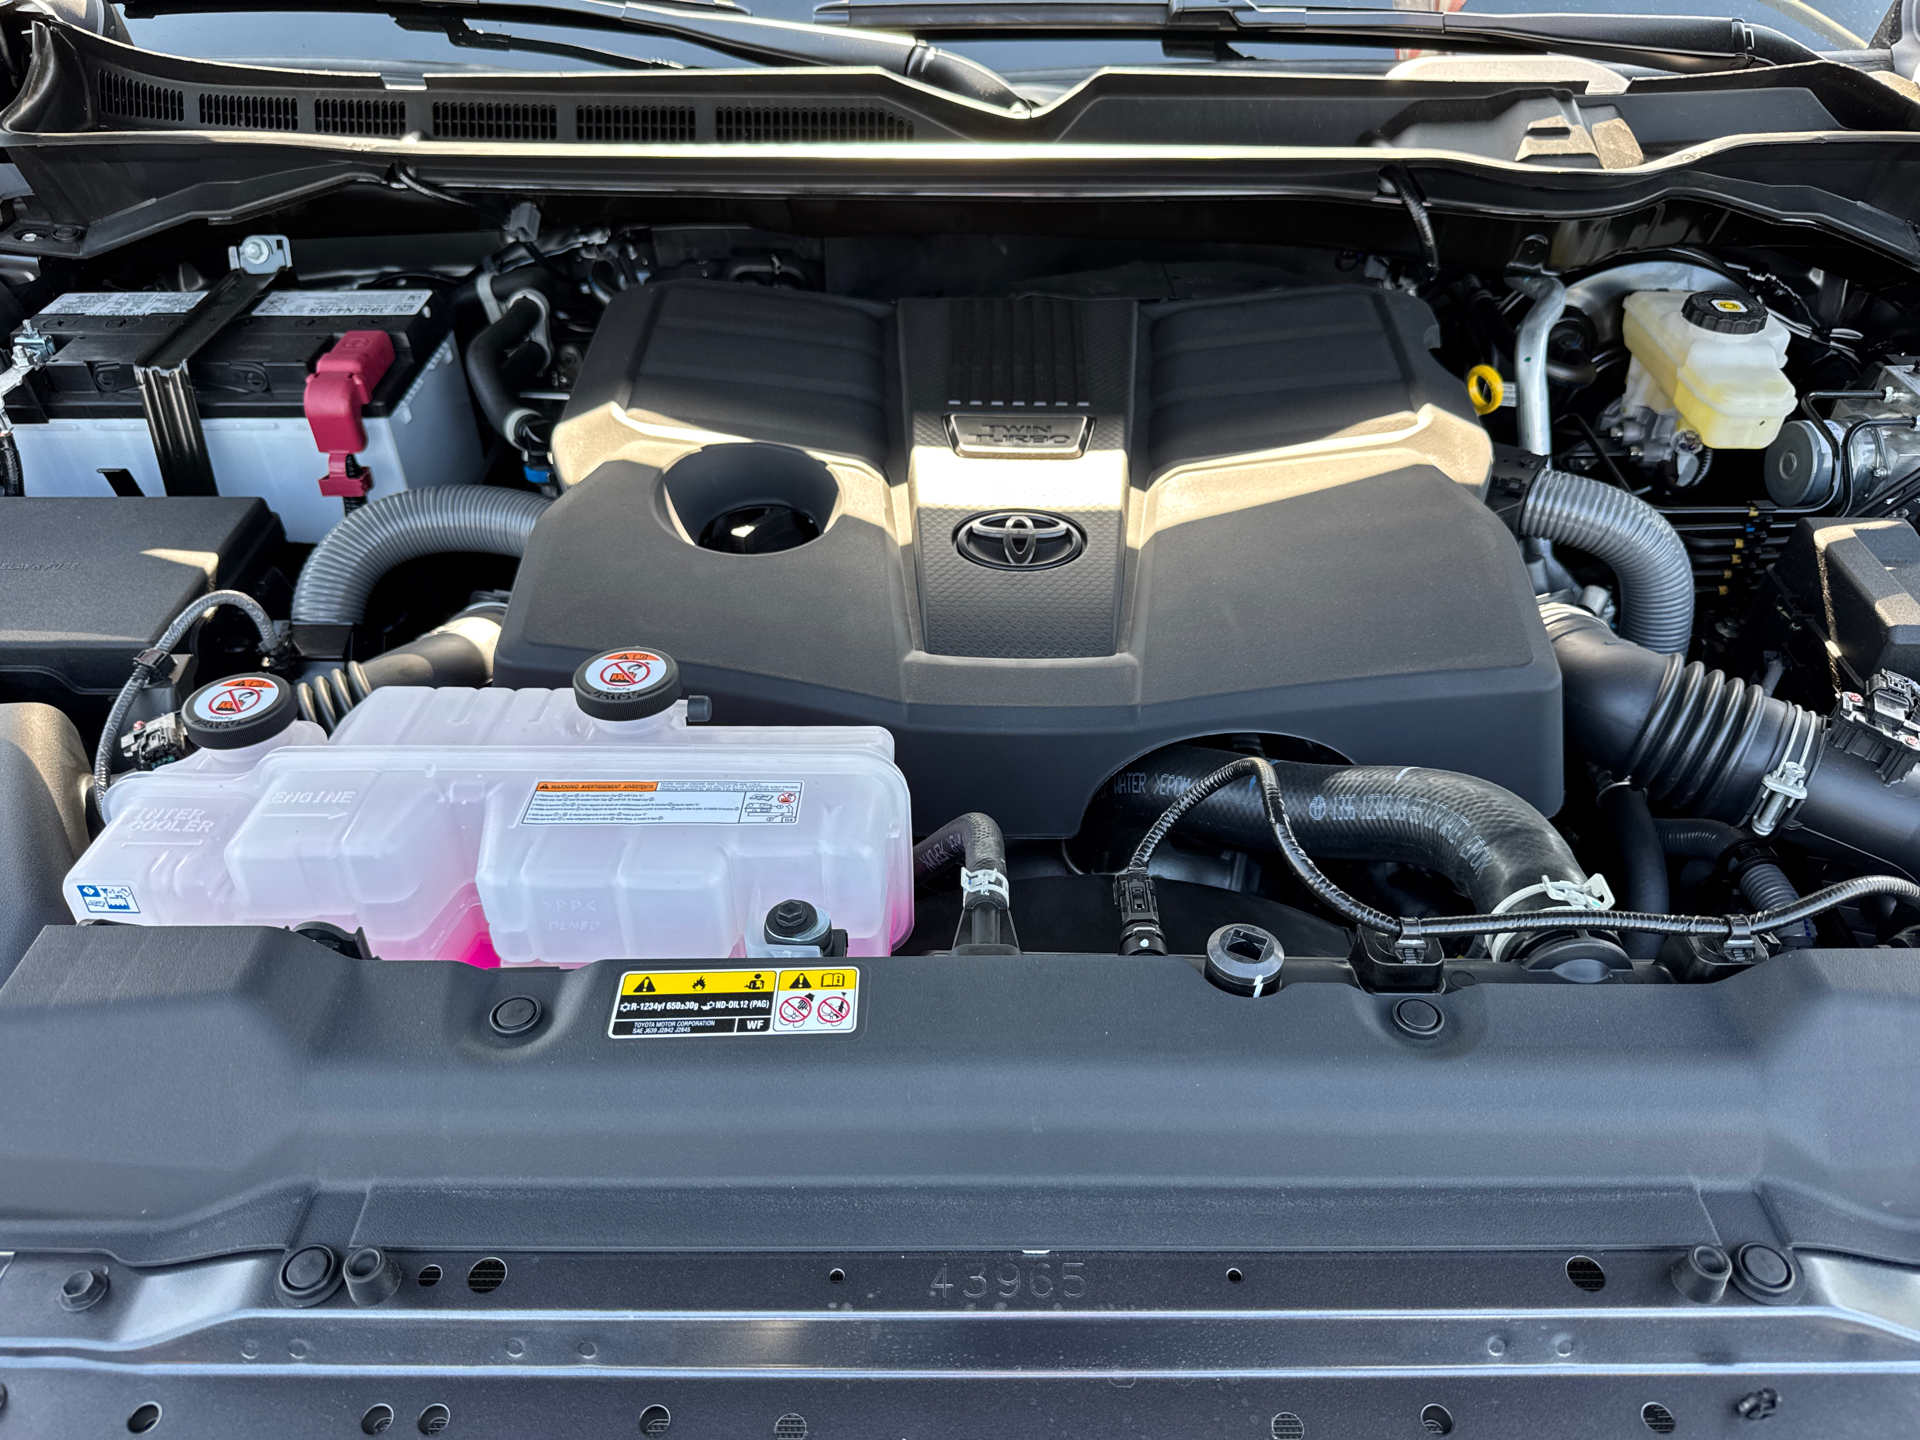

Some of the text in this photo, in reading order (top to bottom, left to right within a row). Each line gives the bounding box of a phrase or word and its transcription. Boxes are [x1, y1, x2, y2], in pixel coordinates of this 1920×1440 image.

[981, 424, 1052, 433] TWIN
[968, 434, 1070, 443] TURBO
[1114, 772, 1147, 794] WATER
[271, 791, 355, 803] ENGINE
[135, 808, 205, 820] INTER
[129, 820, 214, 832] COOLER
[630, 1002, 665, 1011] R-1234yf
[666, 1001, 699, 1011] 650±30g
[749, 1000, 770, 1009] (PAG)
[746, 1020, 764, 1029] WF
[931, 1263, 1087, 1298] 43965
